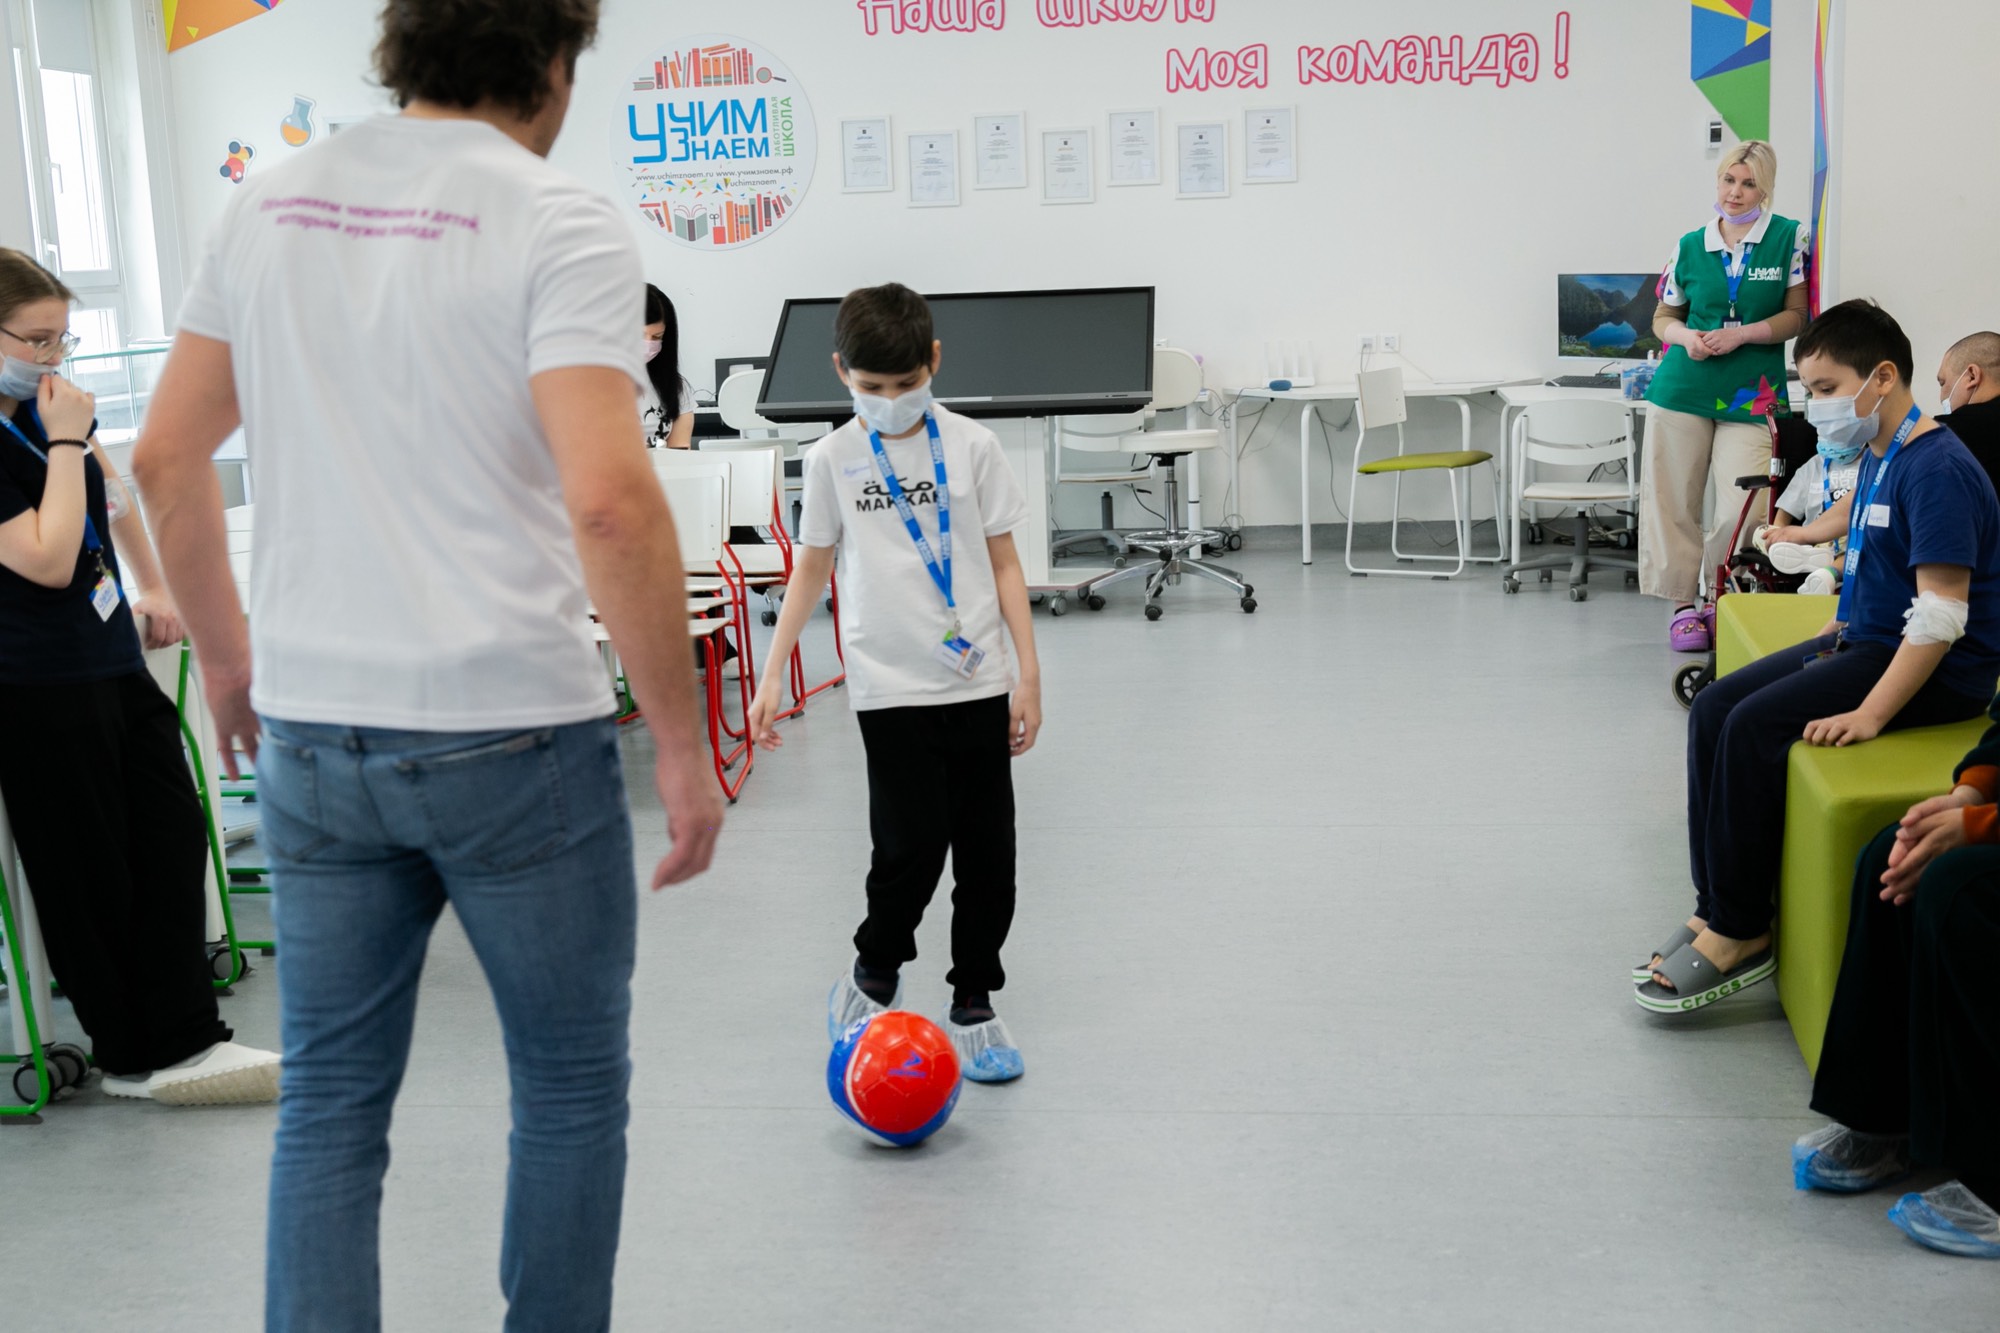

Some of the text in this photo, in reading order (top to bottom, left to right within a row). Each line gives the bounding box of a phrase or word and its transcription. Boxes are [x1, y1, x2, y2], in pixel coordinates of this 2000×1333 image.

[857, 0, 1006, 35] Наша
[1166, 43, 1267, 93] Моя
[628, 97, 768, 164] УЧИМ
[670, 127, 770, 162] ЗНАЕМ
[771, 96, 782, 157] ЗАБОТЛИВАЯ
[780, 96, 795, 157] ШКОЛА
[636, 166, 794, 181] www.uchimznaem.ru www.учимзнаем.рф
[1681, 979, 1742, 1010] crocs
